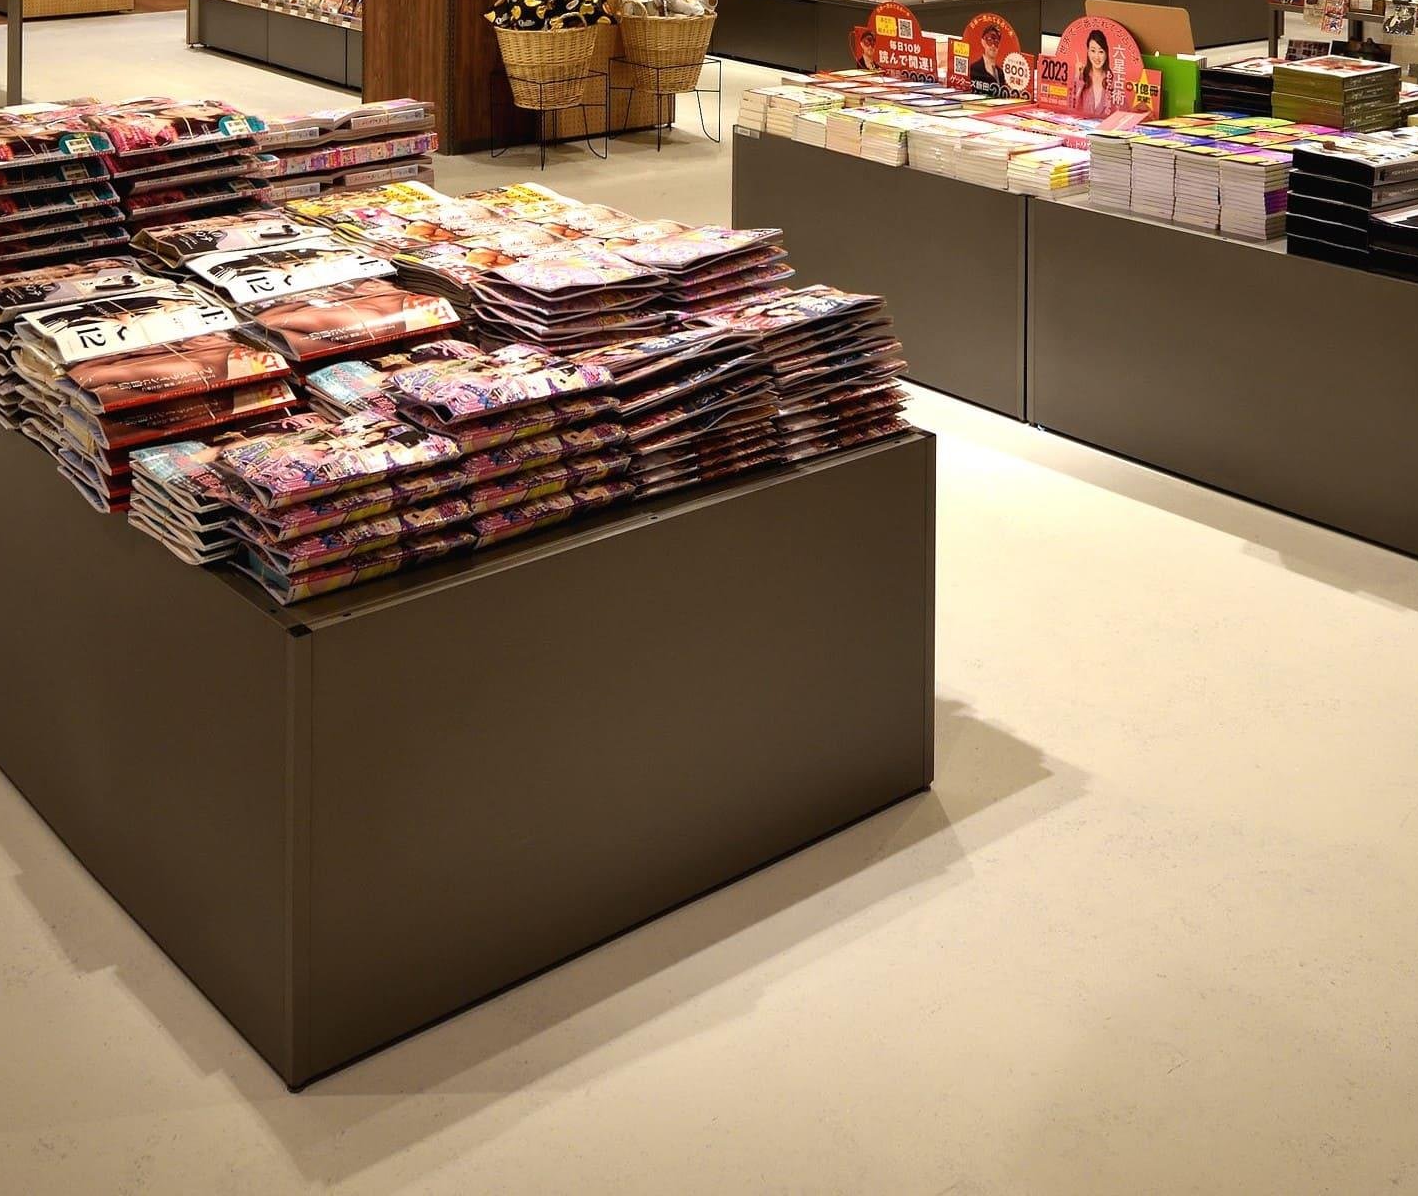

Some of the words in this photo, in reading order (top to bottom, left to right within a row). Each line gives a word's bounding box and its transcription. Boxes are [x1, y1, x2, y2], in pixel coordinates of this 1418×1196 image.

[889, 39, 921, 54] 毎日10秒
[1041, 59, 1068, 82] 2023
[1112, 44, 1126, 106] 六星占術
